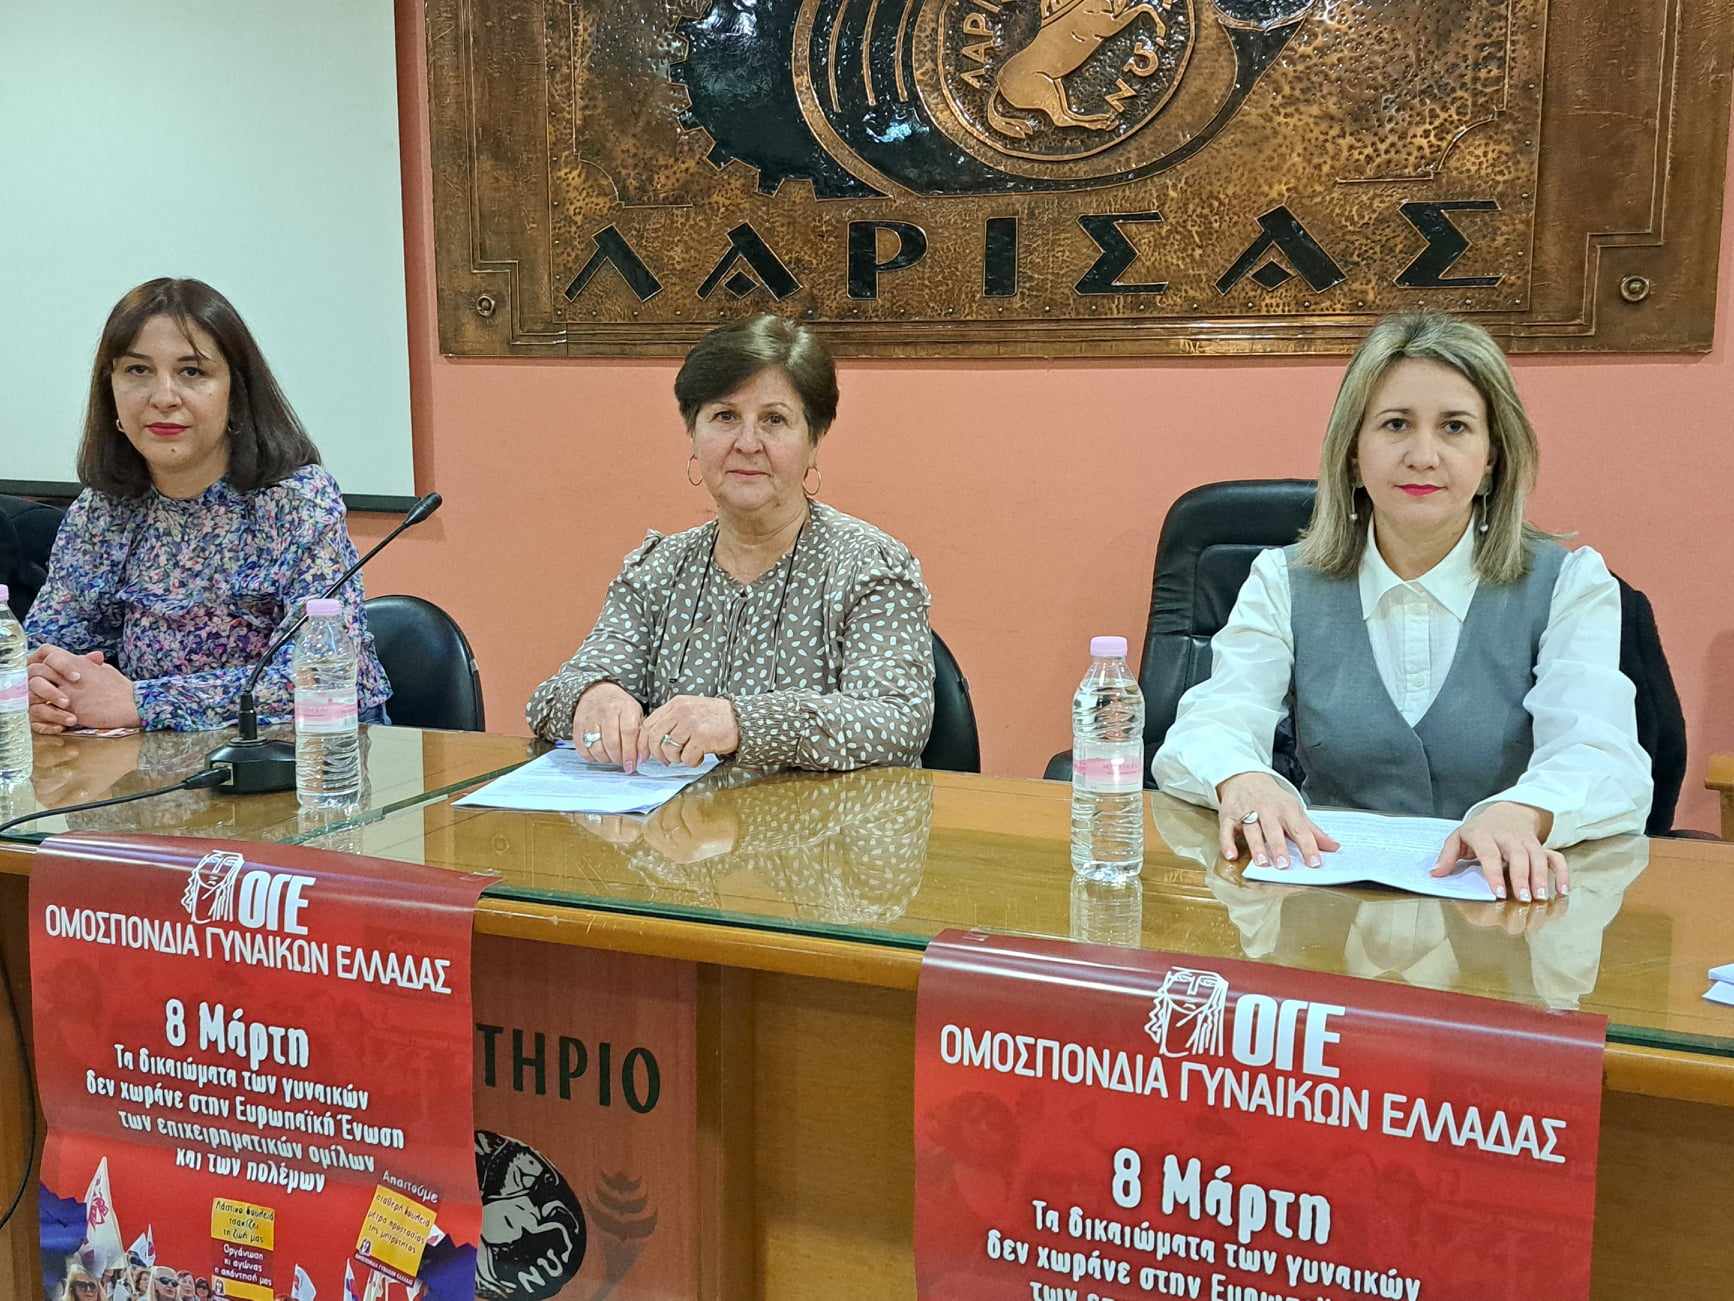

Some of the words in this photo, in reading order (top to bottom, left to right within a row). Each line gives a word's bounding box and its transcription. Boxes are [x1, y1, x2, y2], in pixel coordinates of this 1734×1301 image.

[562, 199, 1502, 303] ΛΑΡΙΣΑΣ
[239, 870, 316, 935] ΟΓΕ
[45, 904, 199, 958] ΟΜΟΣΠΟΝΔΙΑ
[206, 926, 329, 976] ΓΥΝΑΙΚΩΝ
[336, 944, 452, 994] ΕΛΛΑΔΑΣ
[165, 998, 186, 1047] 8
[198, 1001, 310, 1071] Μάρτη
[1231, 994, 1346, 1078] ΟΓΕ
[86, 1069, 115, 1097] δεν
[120, 1082, 184, 1109] χωράνε
[188, 1093, 230, 1118] στην
[235, 1095, 335, 1136] Ευρωπαϊκή
[337, 1113, 405, 1149] Ένωση
[113, 1043, 134, 1070] Τα
[139, 1047, 237, 1088] δικαιώματα
[241, 1071, 276, 1094] των
[282, 1077, 369, 1110] γυναικών
[939, 1023, 1169, 1099] ΟΜΟΣΠΟΝΔΙΑ
[1179, 1062, 1369, 1130] ΓΥΝΑΙΚΩΝ
[1382, 1092, 1567, 1164] ΕΛΛΑΔΑΣ
[118, 1110, 151, 1132] των
[156, 1117, 303, 1160] επιχειρηματικών
[308, 1144, 375, 1173] ομίλων
[175, 1148, 201, 1170] και
[207, 1153, 241, 1177] των
[247, 1160, 325, 1194] πολέμων
[382, 1169, 439, 1203] Απαιτούμε
[1112, 1147, 1142, 1209] 8
[1162, 1150, 1332, 1244] Μάρτη
[223, 1244, 264, 1261] Οργάνωση
[987, 1228, 1029, 1265] δεν
[1036, 1250, 1131, 1285] χωράνε
[1139, 1267, 1201, 1300] στην
[1032, 1199, 1060, 1233] Τα
[1068, 1206, 1216, 1264] δικαιώματα
[1223, 1242, 1278, 1275] των
[1286, 1254, 1421, 1301] γυναικών
